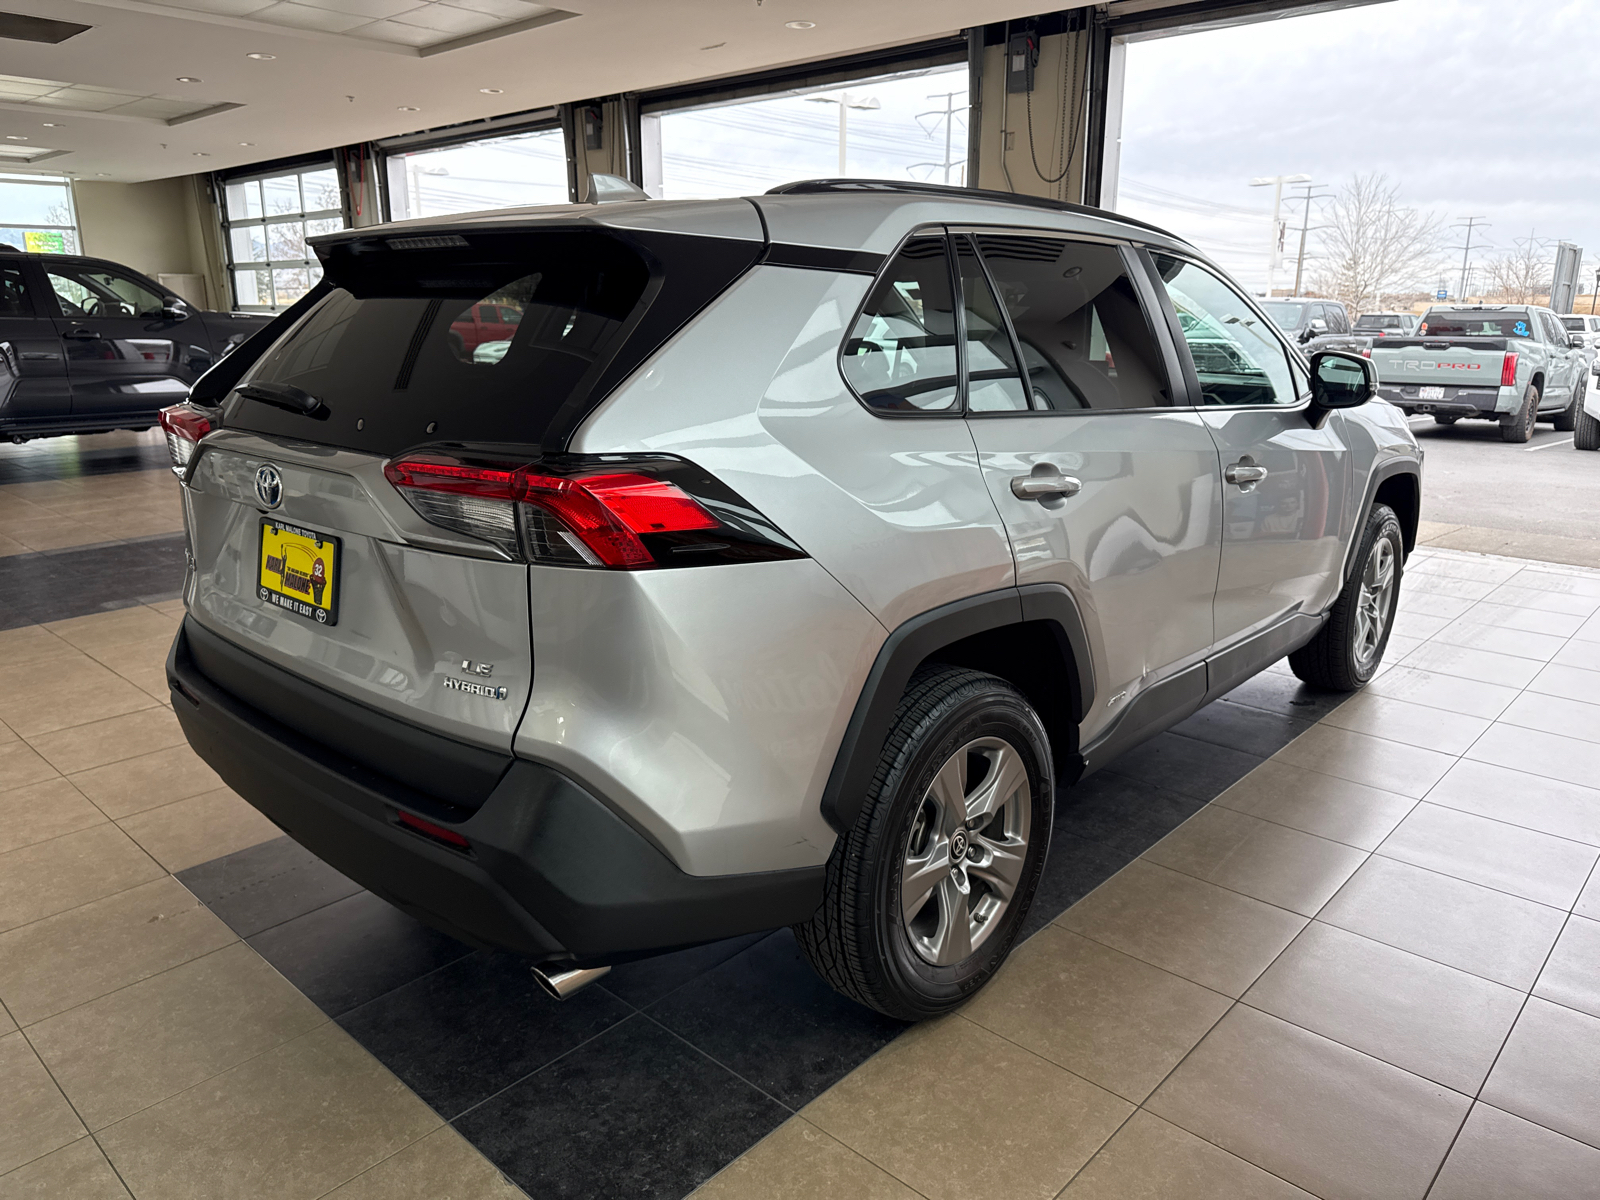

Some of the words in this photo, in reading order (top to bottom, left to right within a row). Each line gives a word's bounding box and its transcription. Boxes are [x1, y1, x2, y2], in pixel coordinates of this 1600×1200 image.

[1388, 359, 1436, 372] TRD
[1437, 362, 1481, 371] PRO
[275, 521, 286, 531] KARL
[285, 524, 302, 536] MALONE
[301, 529, 317, 540] TOYOTA
[314, 563, 323, 578] 32
[284, 571, 311, 596] MALONE
[271, 592, 279, 605] WE
[280, 595, 293, 609] MAKE
[293, 600, 299, 611] IT
[299, 603, 313, 617] EASY
[461, 659, 494, 678] LE
[443, 675, 496, 699] HYBRID
